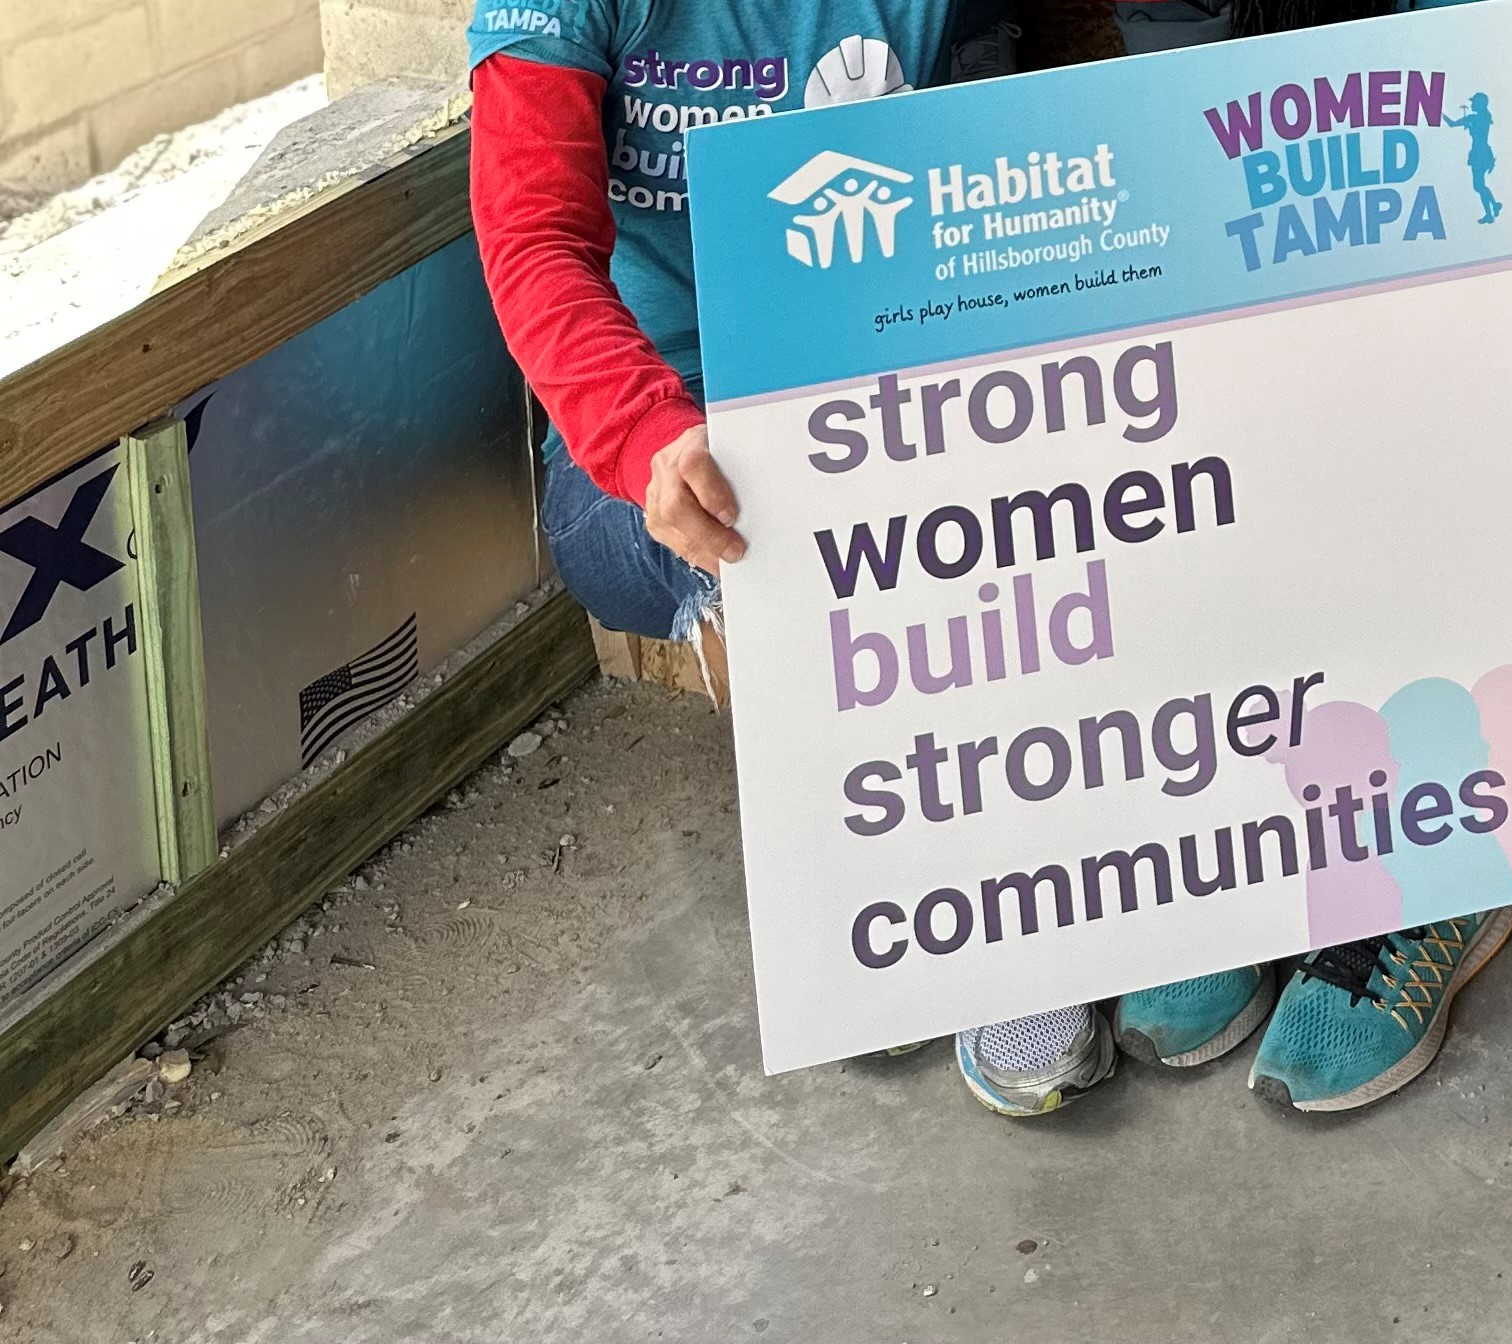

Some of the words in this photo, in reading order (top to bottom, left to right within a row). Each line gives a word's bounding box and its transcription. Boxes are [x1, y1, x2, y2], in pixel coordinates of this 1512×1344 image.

[484, 8, 562, 38] TAMPA
[622, 49, 789, 104] strong
[1203, 70, 1446, 161] WOMEN
[928, 144, 1117, 216] Habitat
[1245, 128, 1420, 208] BUILD
[932, 222, 974, 250] for
[935, 262, 957, 281] of
[962, 236, 1094, 277] Hillsborough
[1100, 222, 1172, 252] County
[1225, 184, 1447, 273] TAMPA
[873, 308, 915, 333] girls
[919, 299, 954, 325] play
[957, 290, 1010, 313] house,
[1013, 282, 1072, 302] women
[1074, 272, 1119, 292] build
[1122, 264, 1163, 284] them
[806, 340, 1180, 475] strong
[813, 455, 1236, 599] women
[828, 558, 1115, 711] build
[841, 670, 1325, 838] stronger
[82, 875, 115, 904] Approval
[850, 769, 1509, 970] communities
